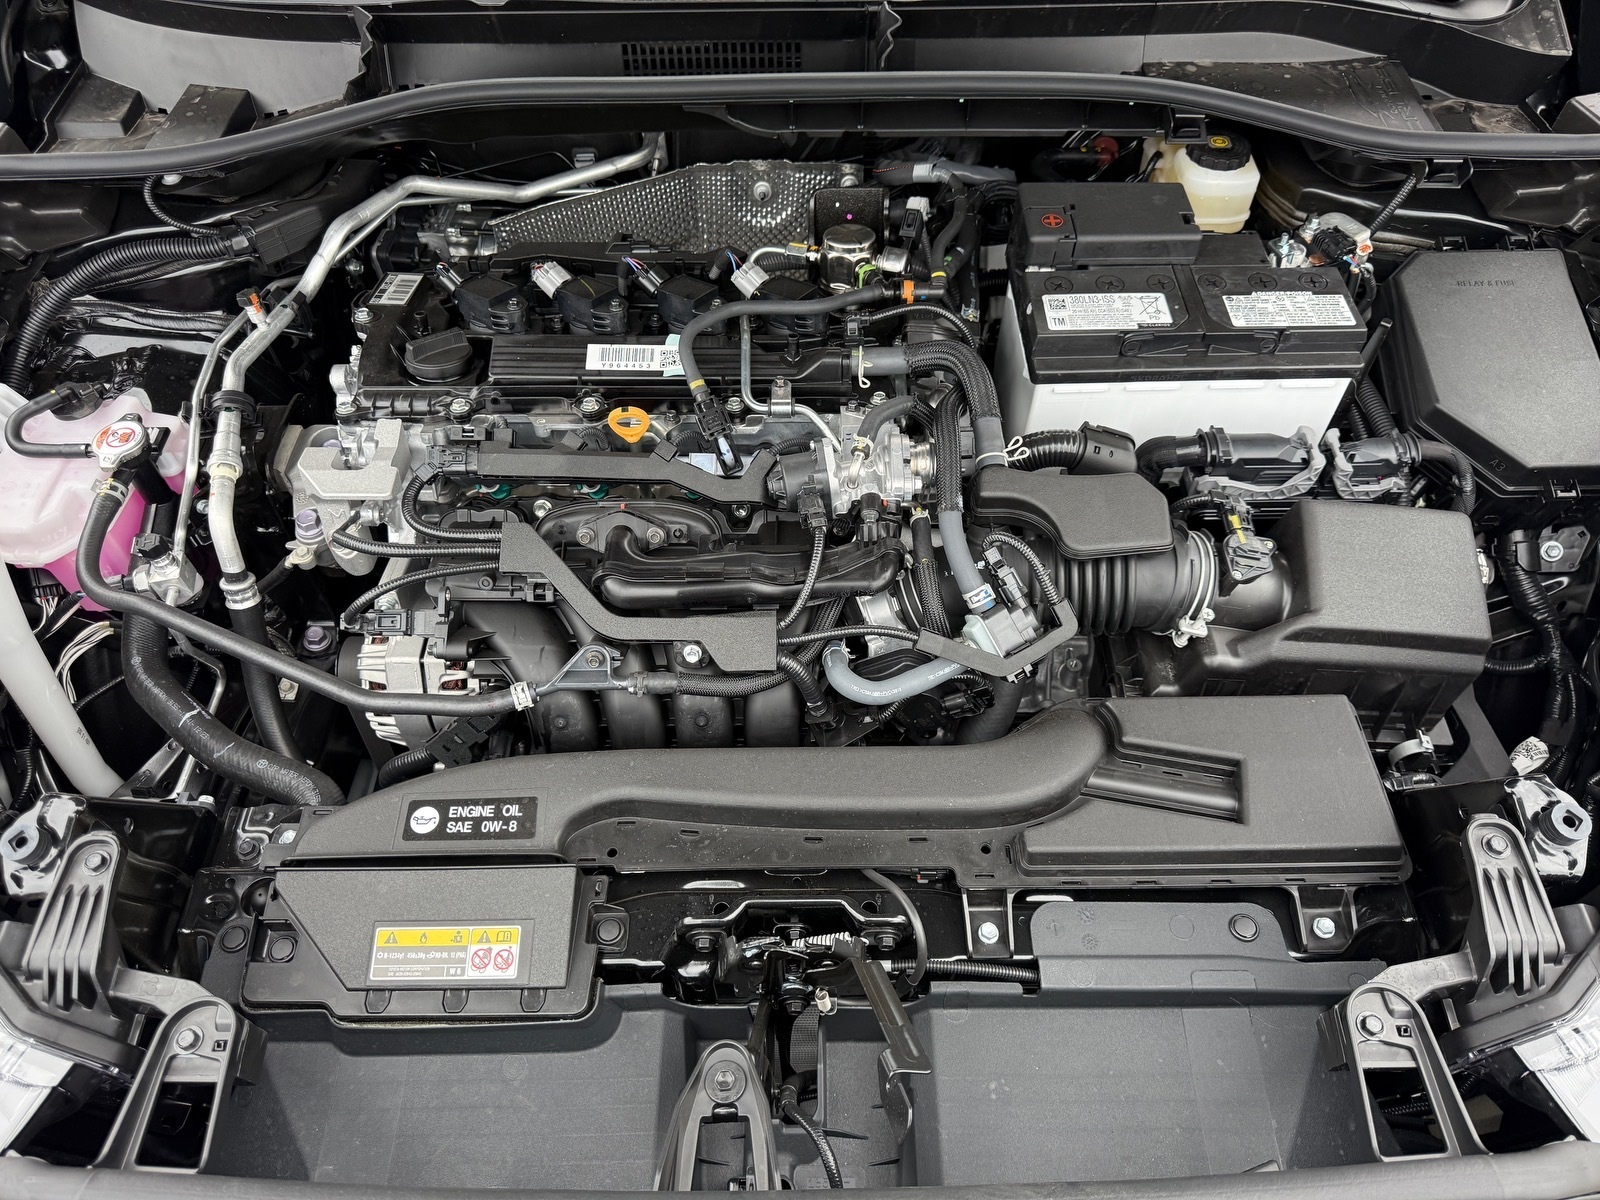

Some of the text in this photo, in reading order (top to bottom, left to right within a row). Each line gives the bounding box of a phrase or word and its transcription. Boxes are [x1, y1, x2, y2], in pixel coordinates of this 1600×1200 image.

[1069, 295, 1115, 304] 380LN3-ISS
[1052, 317, 1066, 326] TM
[1488, 458, 1506, 472] A3
[448, 804, 523, 818] ENGINE OIL
[446, 820, 518, 833] SAE 0W-8
